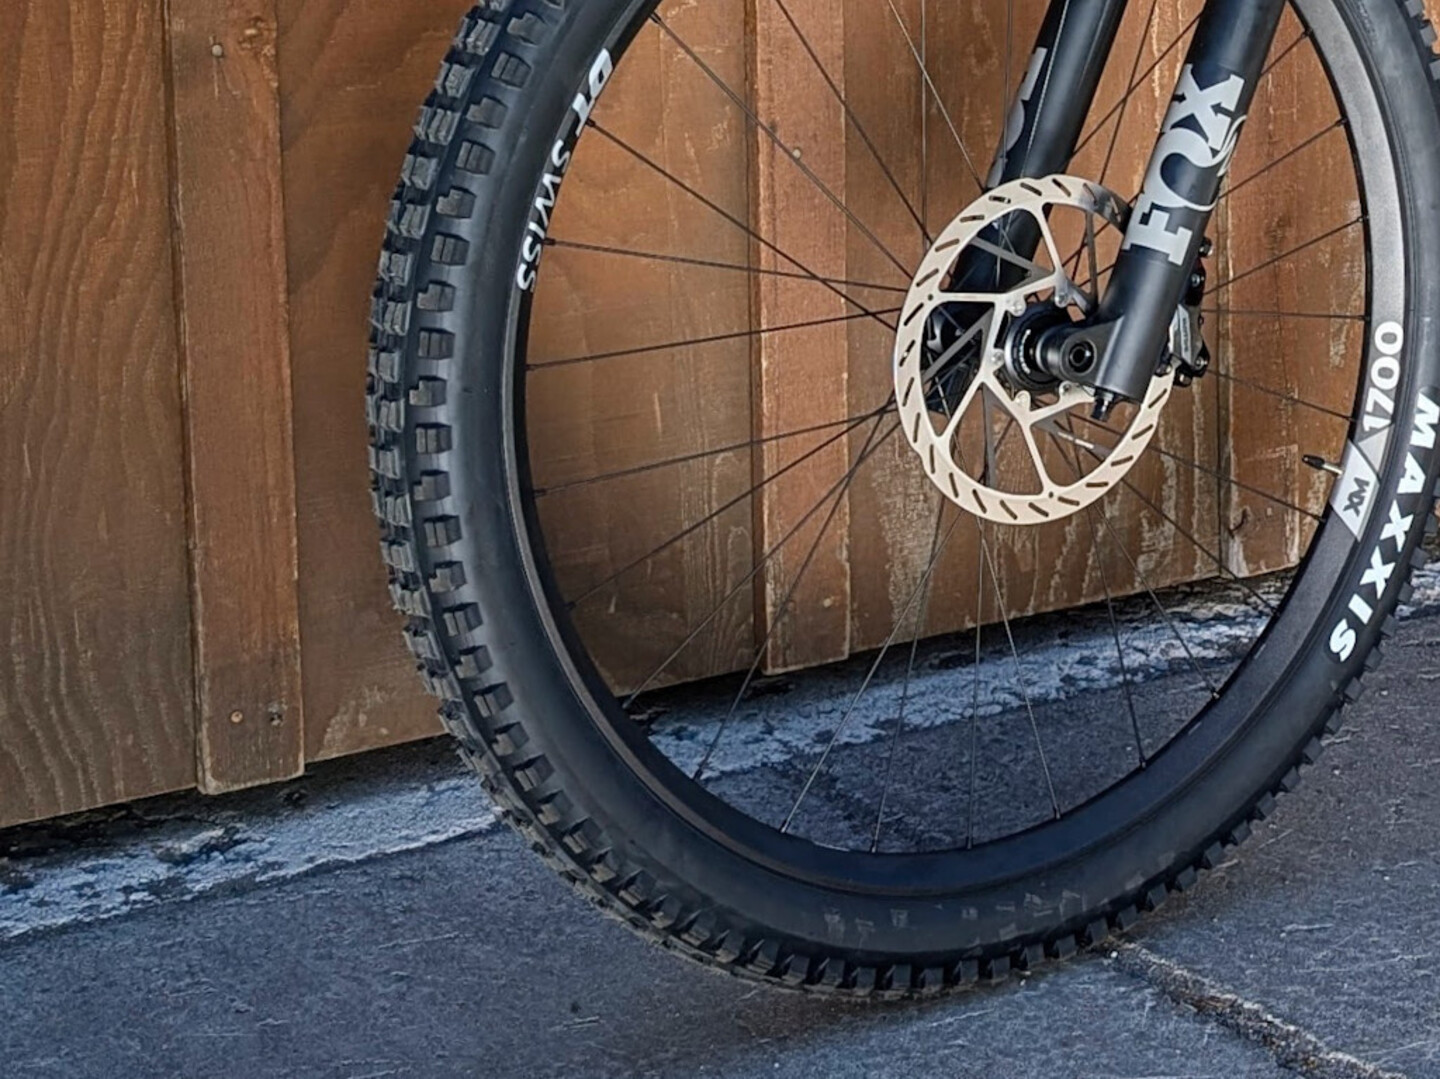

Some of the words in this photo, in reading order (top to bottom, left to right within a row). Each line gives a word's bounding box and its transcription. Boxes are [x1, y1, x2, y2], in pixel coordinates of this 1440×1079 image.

[571, 48, 613, 137] DT
[1121, 63, 1247, 266] FOX
[516, 139, 571, 294] SWISS
[1362, 320, 1405, 433] 1700
[1328, 390, 1440, 662] MAXXIS
